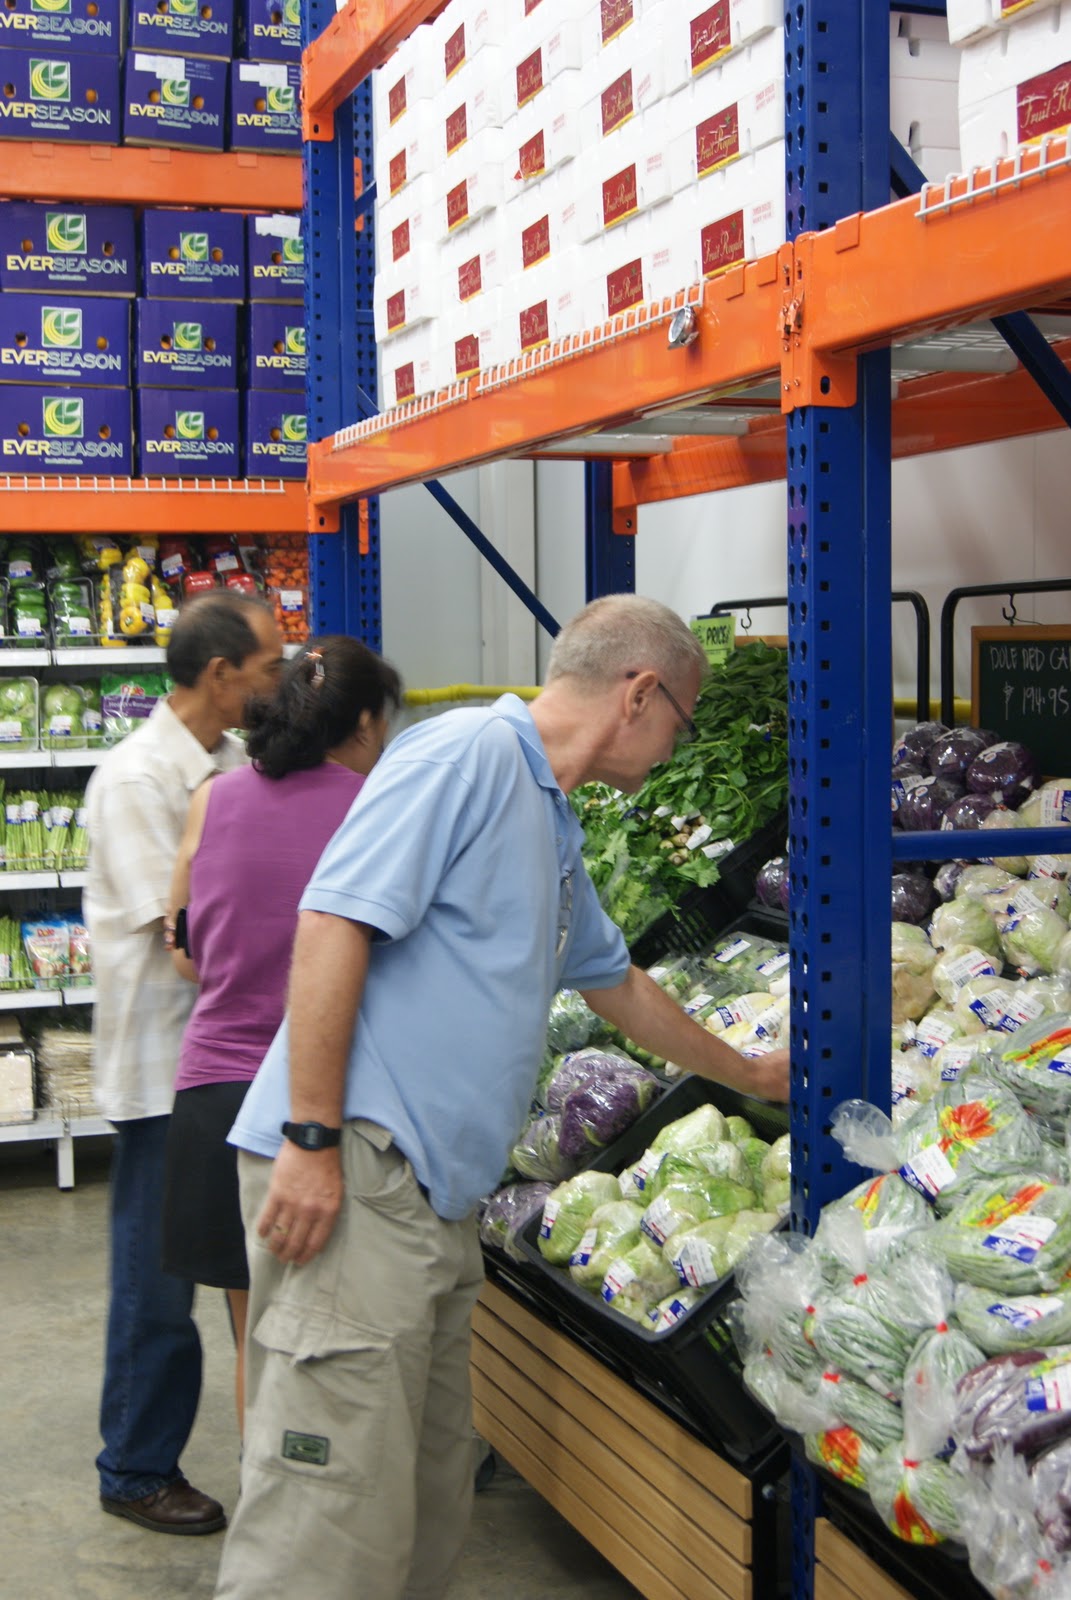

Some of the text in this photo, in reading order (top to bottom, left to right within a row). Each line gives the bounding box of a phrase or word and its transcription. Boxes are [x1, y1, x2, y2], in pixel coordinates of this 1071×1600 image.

[137, 12, 228, 34] EVERSEASON
[253, 24, 301, 40] EVERS
[129, 103, 219, 126] EVERSEASON
[6, 255, 127, 275] EVERSEASON
[150, 261, 240, 277] EVERSEASON
[254, 265, 304, 278] EVERSE
[1, 348, 121, 371] EVERSEASON
[143, 350, 232, 368] EVERSEASON
[256, 355, 306, 370] EVERSE
[3, 439, 123, 458] EVERSEASON
[146, 440, 235, 455] EVERSEASON
[252, 442, 306, 456] EVERSE
